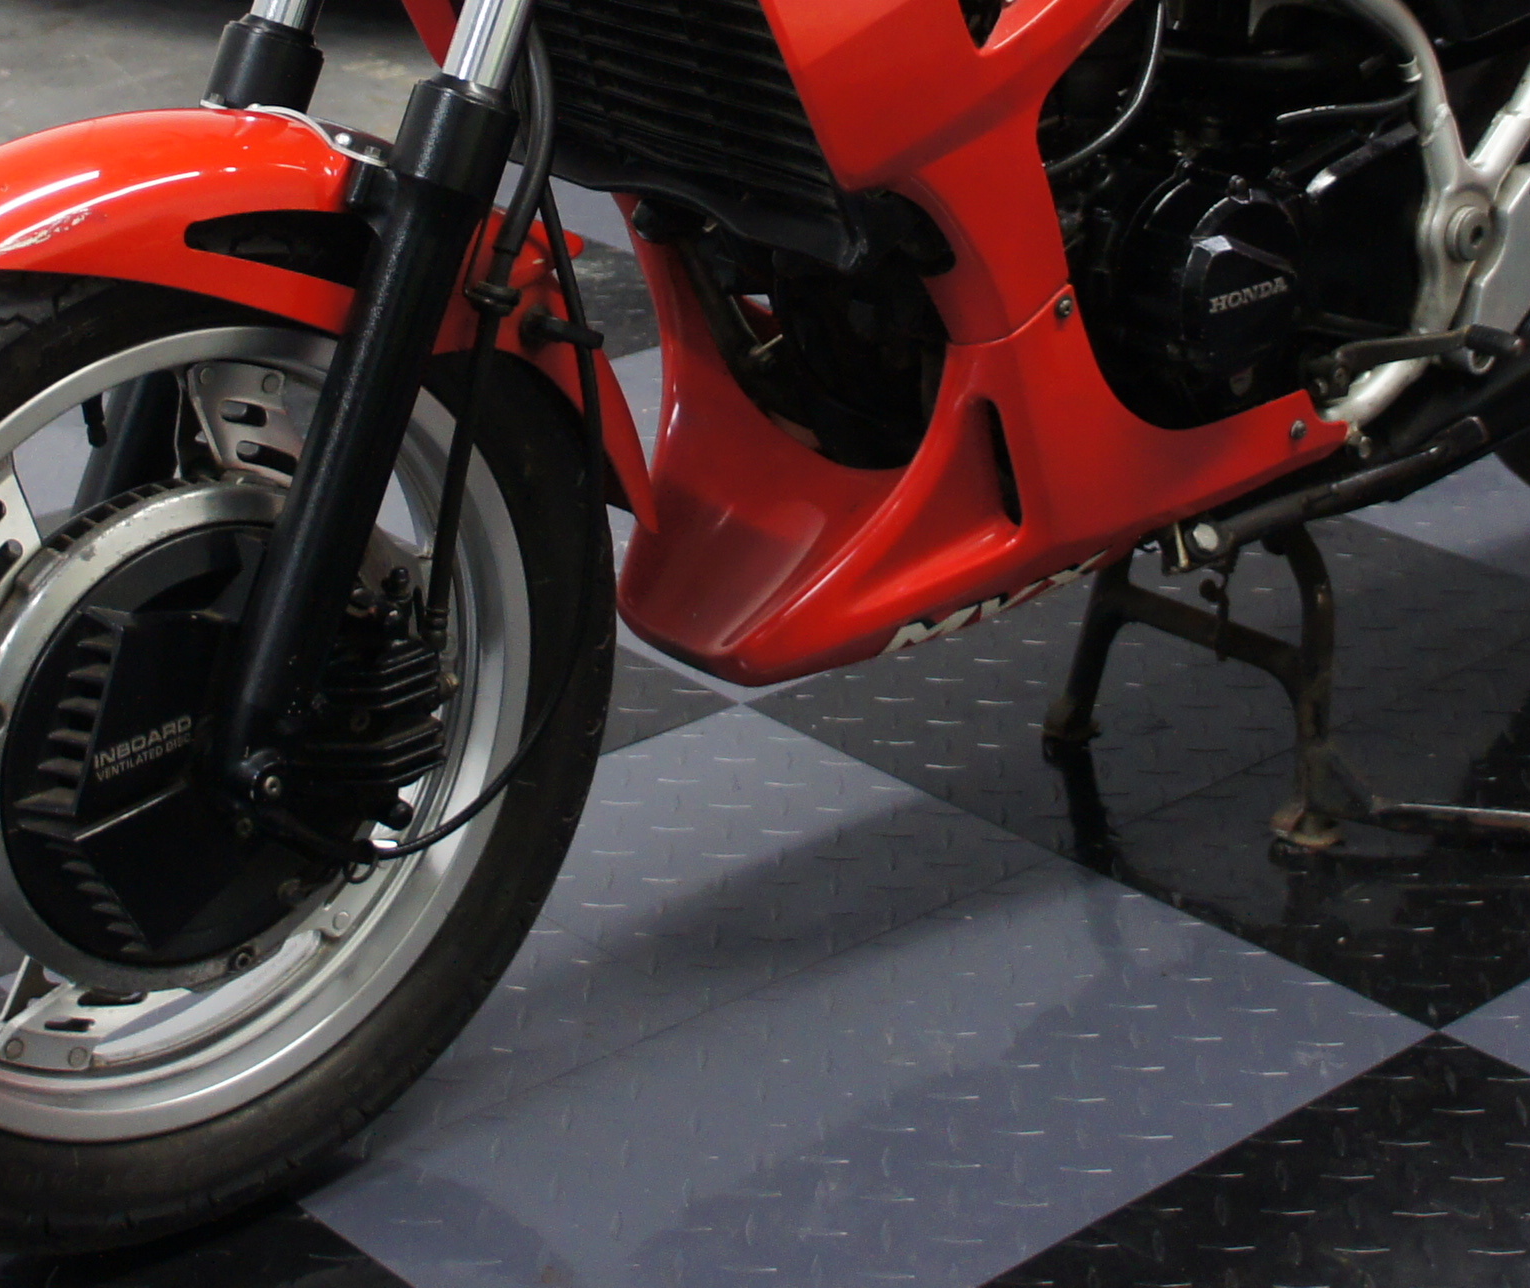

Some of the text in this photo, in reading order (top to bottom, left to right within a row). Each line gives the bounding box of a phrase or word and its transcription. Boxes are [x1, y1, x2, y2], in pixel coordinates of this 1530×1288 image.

[1209, 276, 1288, 314] HONDA
[93, 714, 192, 769] INBOARD
[95, 746, 164, 782] VENTILATED
